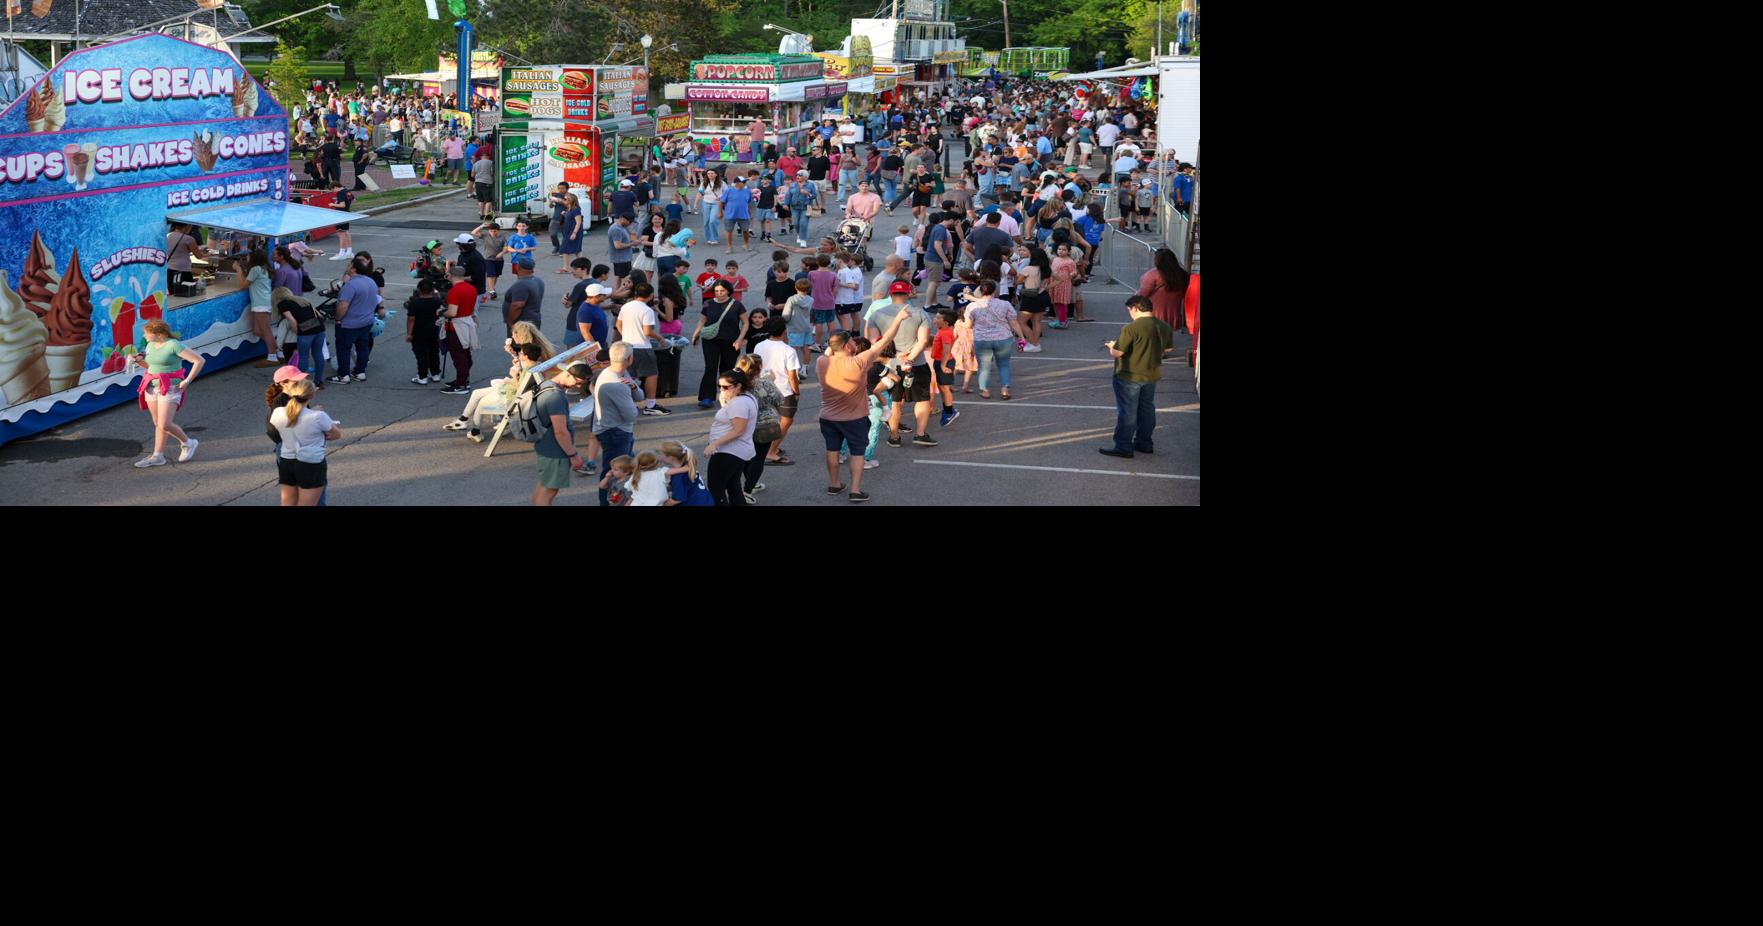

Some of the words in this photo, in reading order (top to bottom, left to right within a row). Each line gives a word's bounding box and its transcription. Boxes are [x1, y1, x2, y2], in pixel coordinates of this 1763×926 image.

[511, 70, 553, 80] ITALIAN
[604, 71, 632, 80] ITALIAN
[707, 65, 775, 79] POPCORN
[63, 69, 122, 103] ICE
[128, 67, 234, 99] CREAM
[506, 80, 560, 91] SAUSAGES
[600, 80, 635, 90] SAUSAGES
[689, 89, 729, 98] COTTON
[731, 89, 766, 99] CANDY
[529, 97, 561, 106] HOT
[529, 106, 562, 115] DOGS
[551, 136, 589, 145] ITALIAN
[95, 139, 194, 174] SHAKES
[219, 131, 286, 159] CONES
[505, 149, 540, 164] DRINKS
[547, 160, 591, 169] SAUSAGE
[505, 170, 541, 185] DRINKS
[166, 191, 190, 208] ICE
[191, 185, 225, 203] COLD
[227, 179, 268, 197] DRINKS
[504, 190, 540, 206] DRINKS
[90, 246, 167, 281] SLUSHIES
